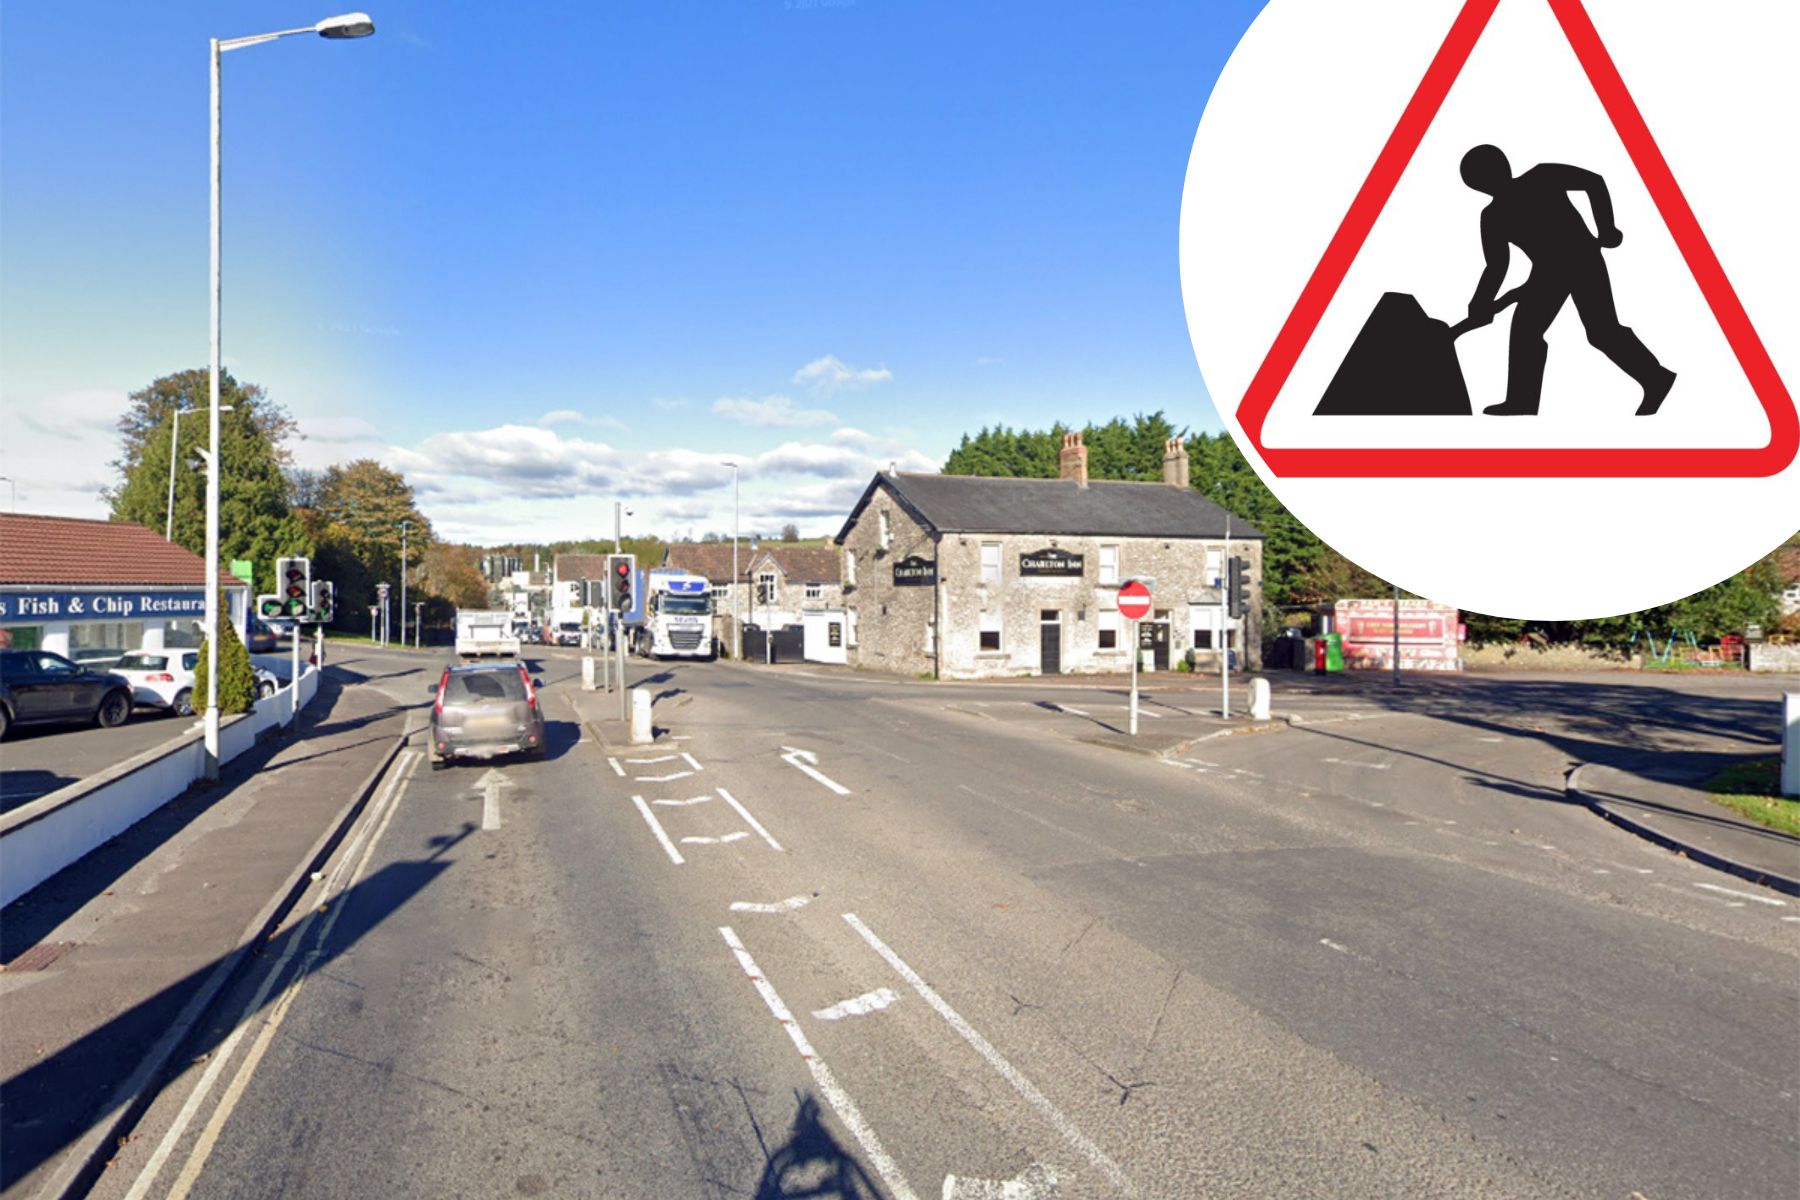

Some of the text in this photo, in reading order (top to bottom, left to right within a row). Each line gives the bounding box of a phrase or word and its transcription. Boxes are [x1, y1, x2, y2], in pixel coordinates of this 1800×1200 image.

[17, 597, 60, 615] Fish
[67, 596, 85, 614] &
[92, 596, 134, 616] Chip
[140, 595, 206, 612] Restaura
